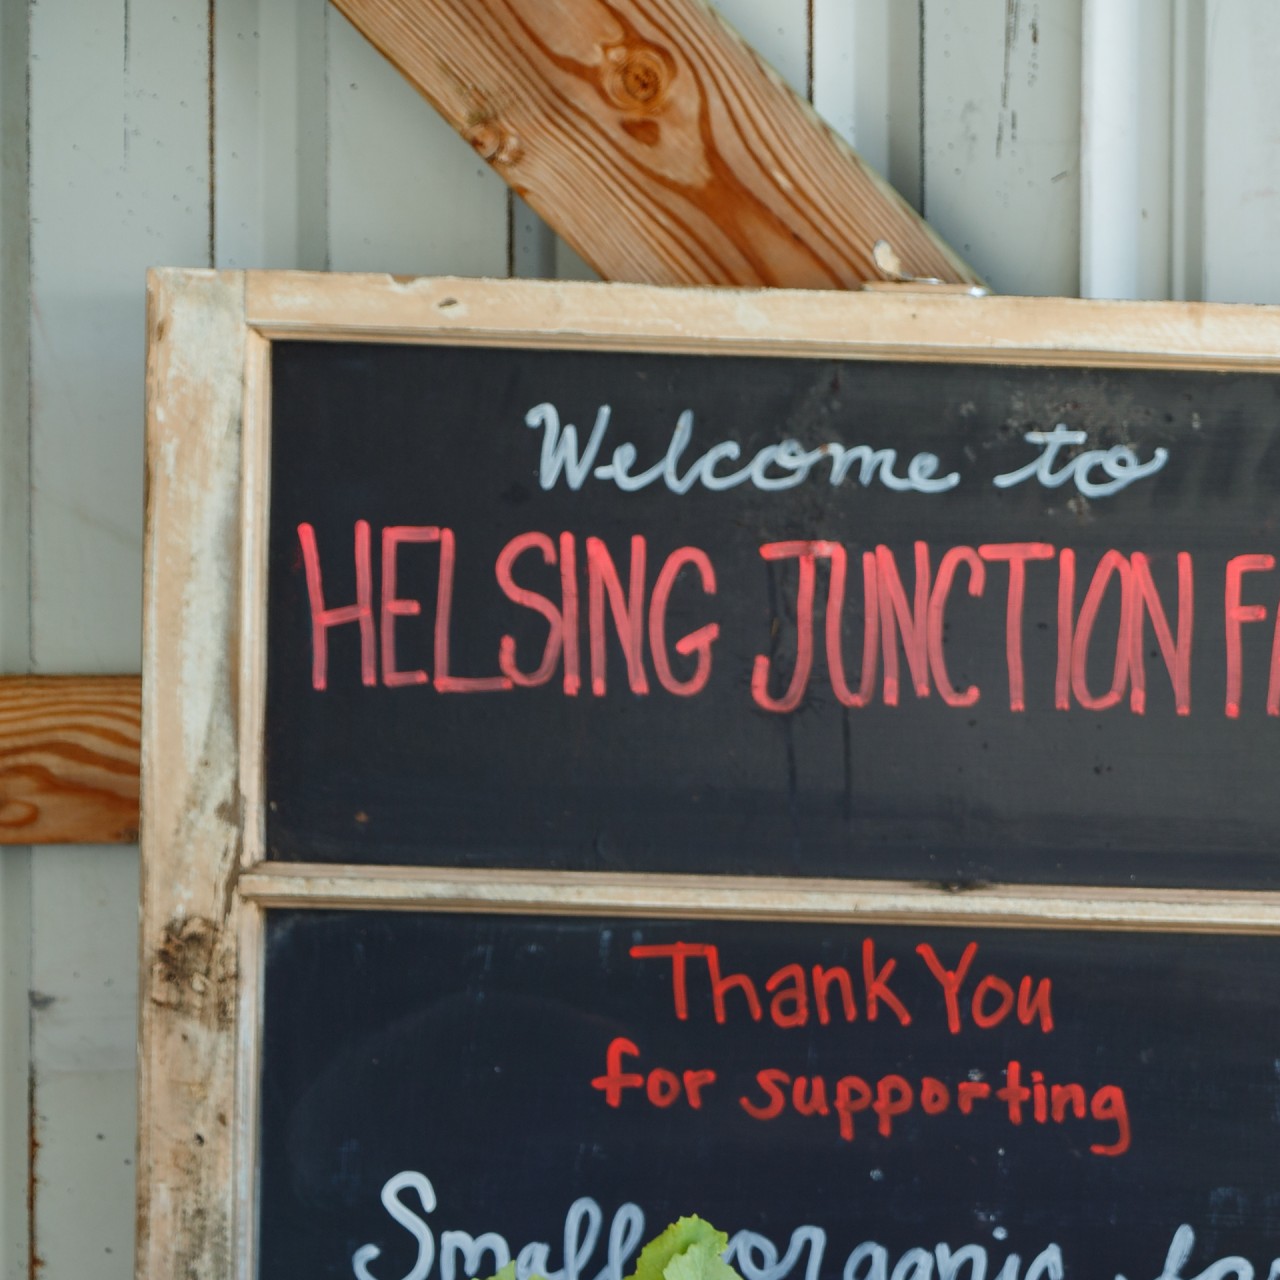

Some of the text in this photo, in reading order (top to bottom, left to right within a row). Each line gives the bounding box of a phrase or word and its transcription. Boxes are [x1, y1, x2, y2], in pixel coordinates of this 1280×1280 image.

[526, 403, 1168, 497] Welcome to
[298, 520, 718, 696] HELSING
[752, 541, 1193, 715] JUNCTION
[630, 939, 1053, 1033] Thank You
[592, 1038, 1131, 1156] for supporting
